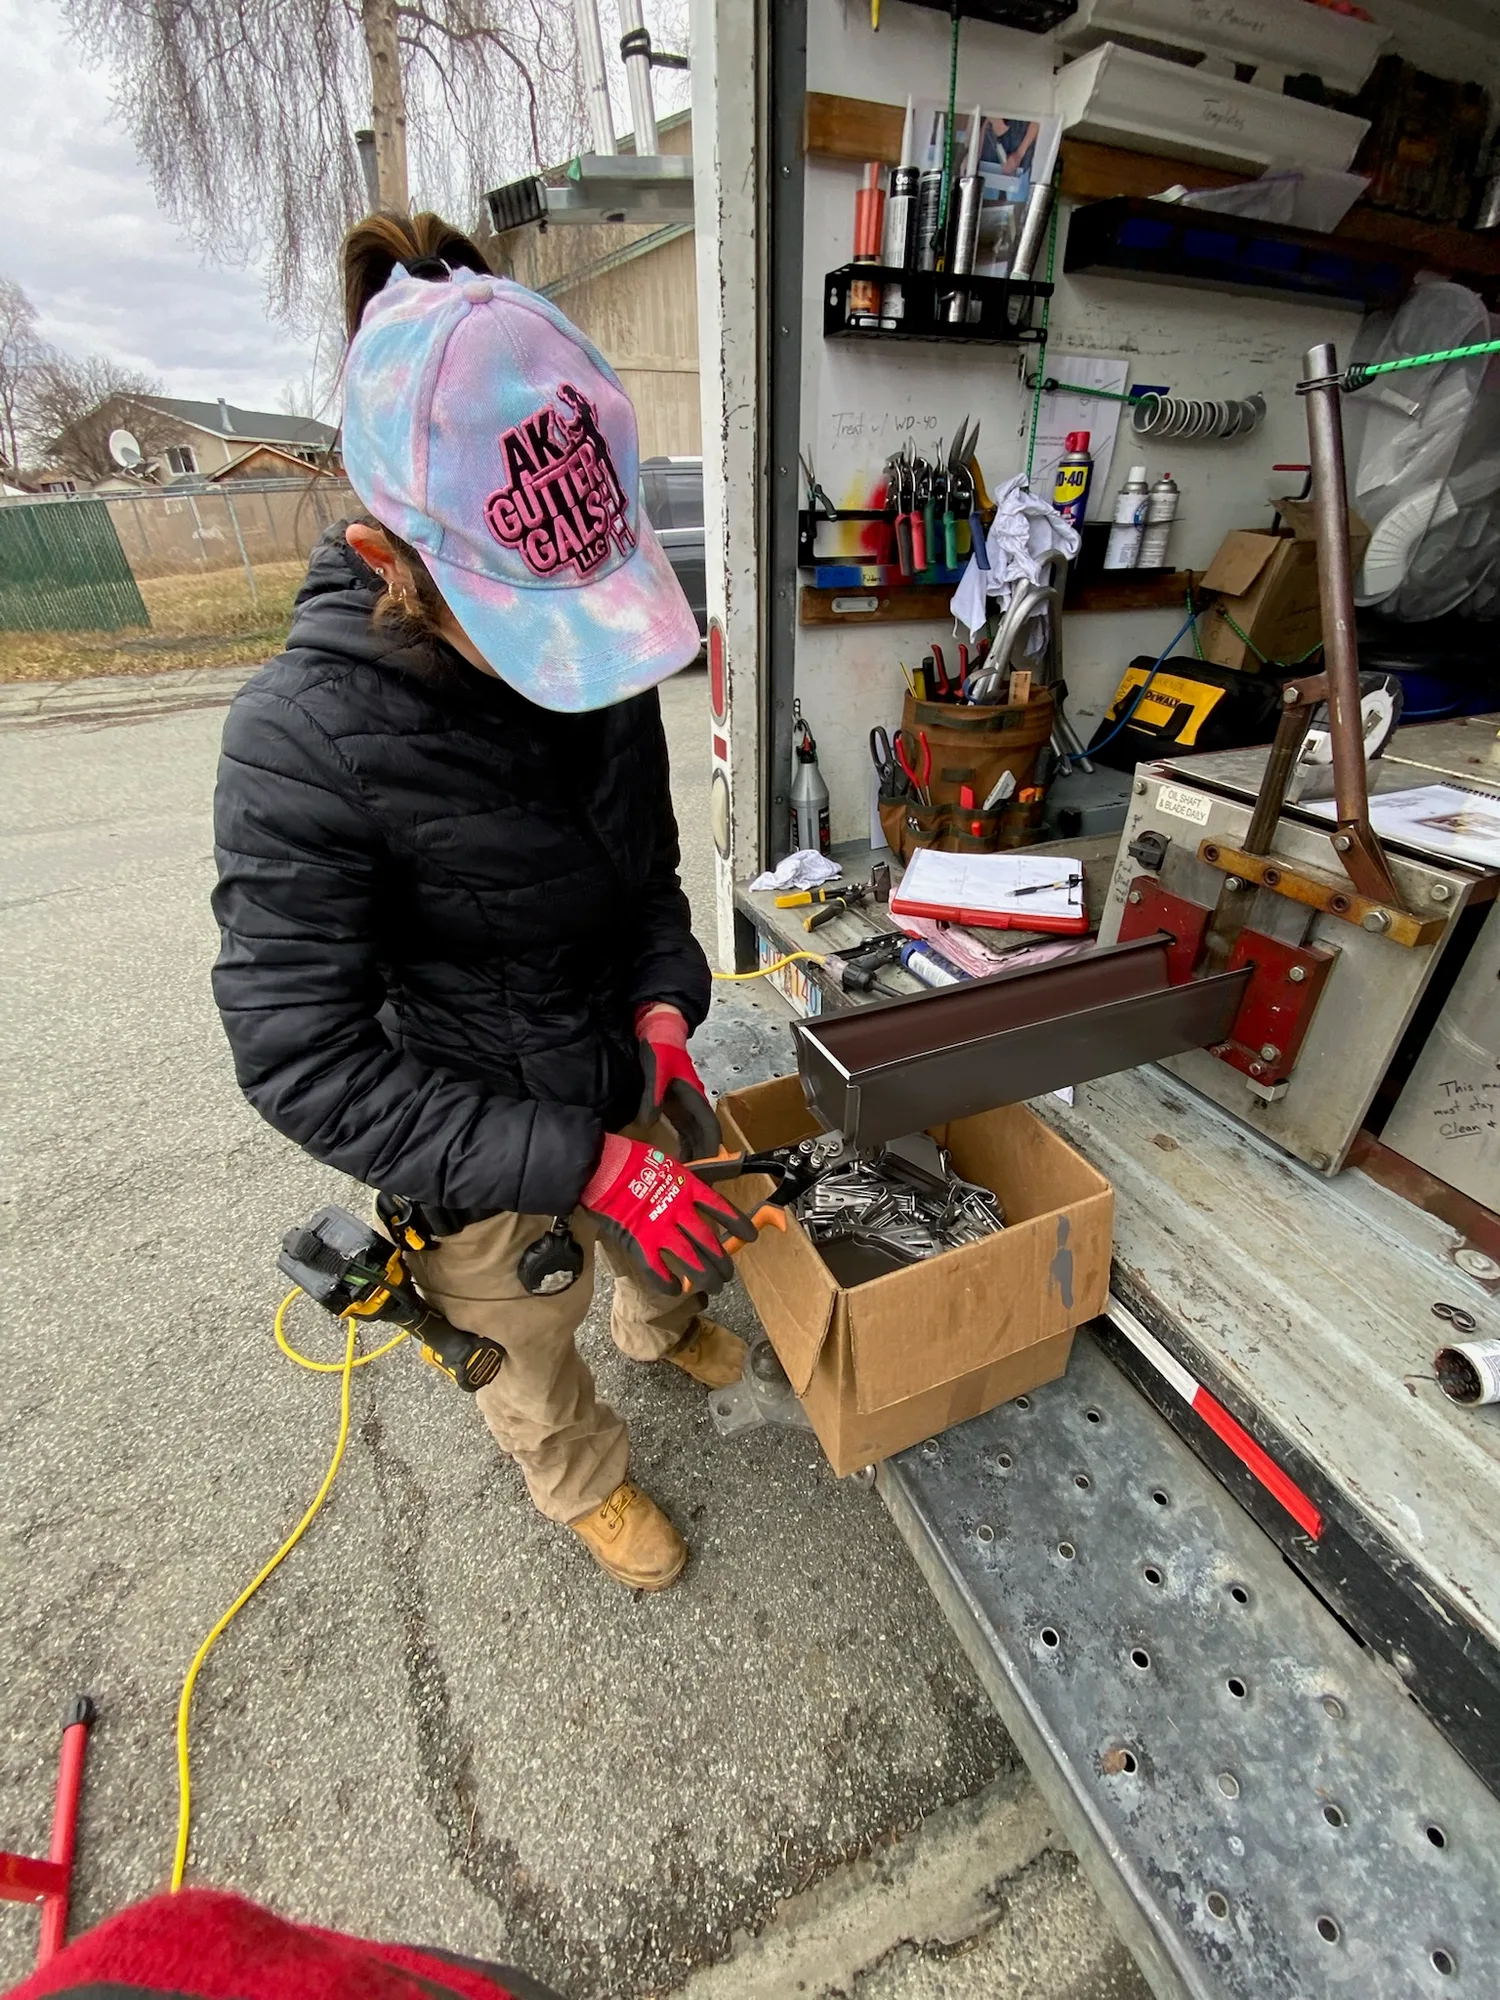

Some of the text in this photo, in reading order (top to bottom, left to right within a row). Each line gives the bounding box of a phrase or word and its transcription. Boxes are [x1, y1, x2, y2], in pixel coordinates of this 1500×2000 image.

[831, 412, 864, 437] Treat
[894, 415, 938, 431] WD-40
[503, 411, 565, 487] AK
[491, 444, 603, 540] GUTTER
[526, 490, 608, 570] GALS
[579, 540, 607, 573] LLC
[1159, 798, 1206, 821] & BLADE DAILY
[1168, 789, 1201, 808] OIL SHAFT
[1438, 1080, 1474, 1097] This
[1433, 1095, 1494, 1116] must stay
[1439, 1121, 1482, 1137] Clean
